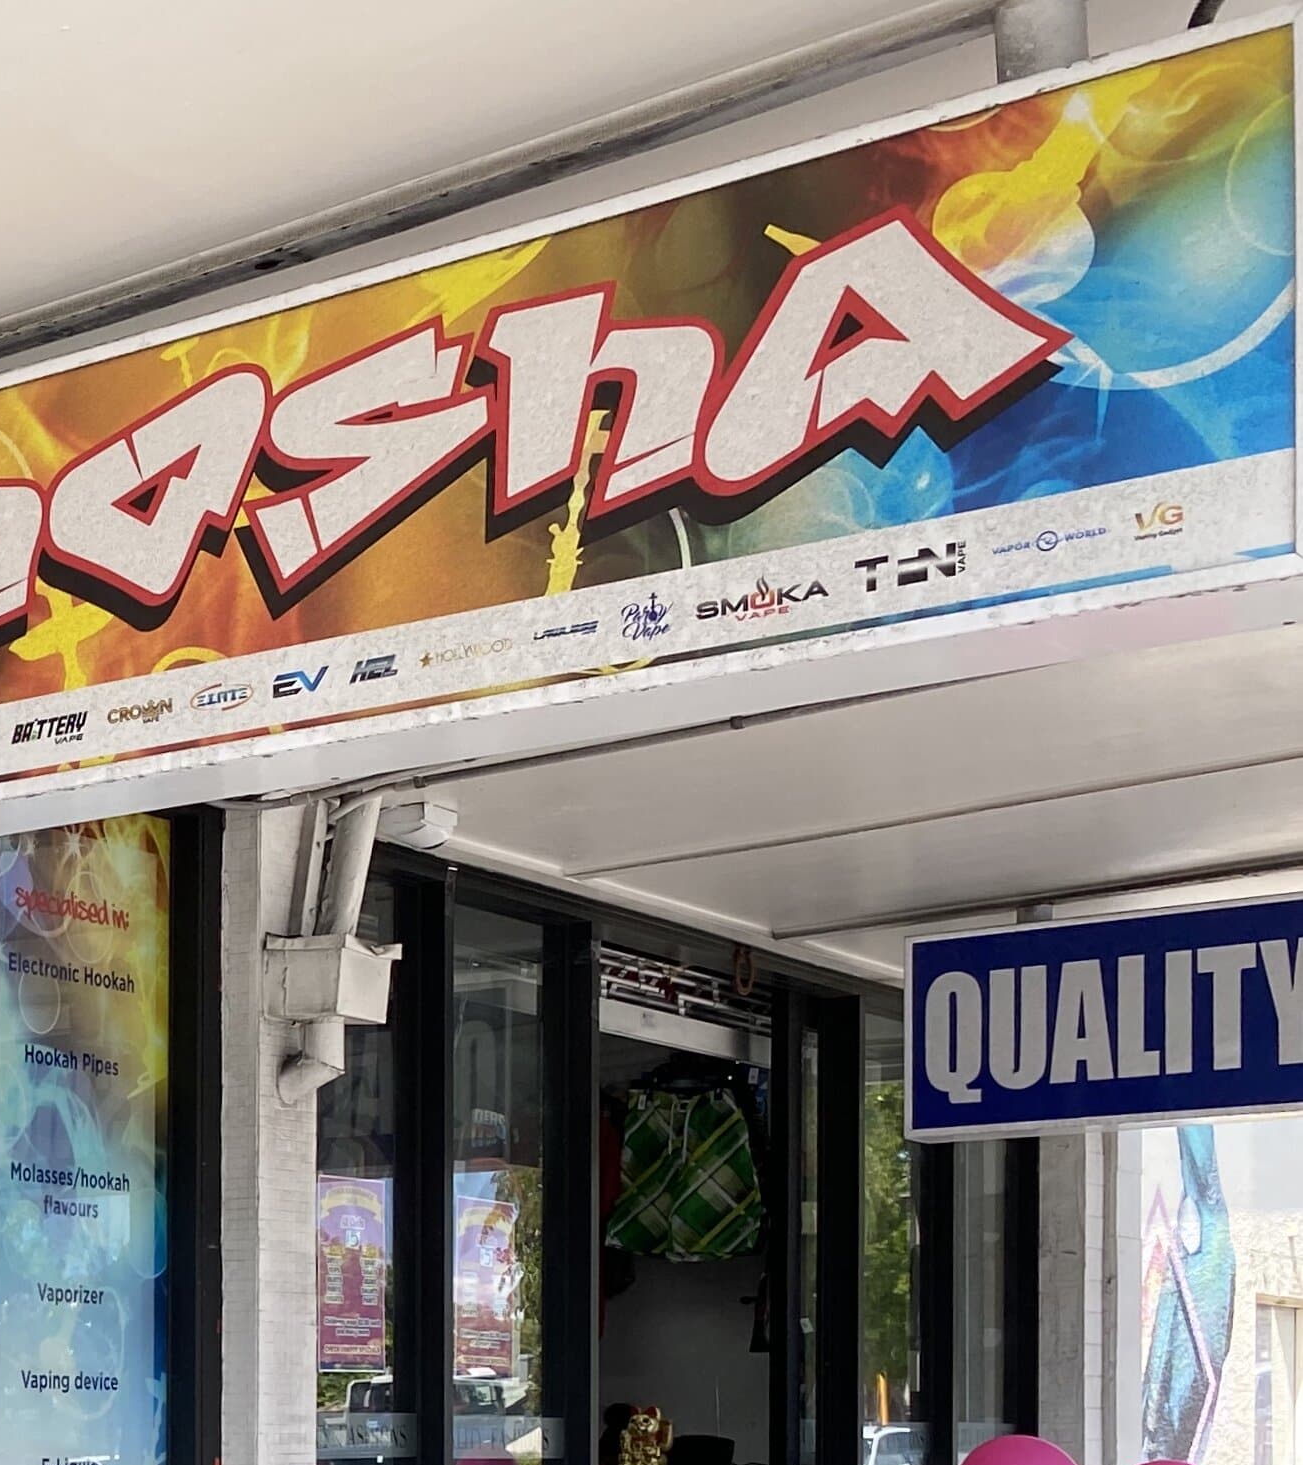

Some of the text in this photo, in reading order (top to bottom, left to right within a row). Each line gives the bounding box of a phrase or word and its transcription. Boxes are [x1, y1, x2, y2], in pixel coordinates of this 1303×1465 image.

[1064, 527, 1107, 542] WORLD
[957, 540, 967, 573] VAPE
[735, 605, 791, 623] VAPE
[621, 620, 672, 641] Vape
[272, 665, 330, 699] EV
[106, 698, 174, 725] CROWN
[11, 711, 89, 744] BATTERY
[54, 733, 84, 745] VAPE
[15, 886, 110, 926] specialised
[8, 952, 135, 993] Electronic Hookah
[923, 937, 1303, 1105] QUALITY
[24, 1044, 120, 1078] Hookah Pipes
[10, 1161, 131, 1194] Molasses/hookah
[43, 1194, 99, 1219] flavours
[37, 1282, 105, 1306] Vaporizer
[21, 1369, 121, 1394] Vaping device
